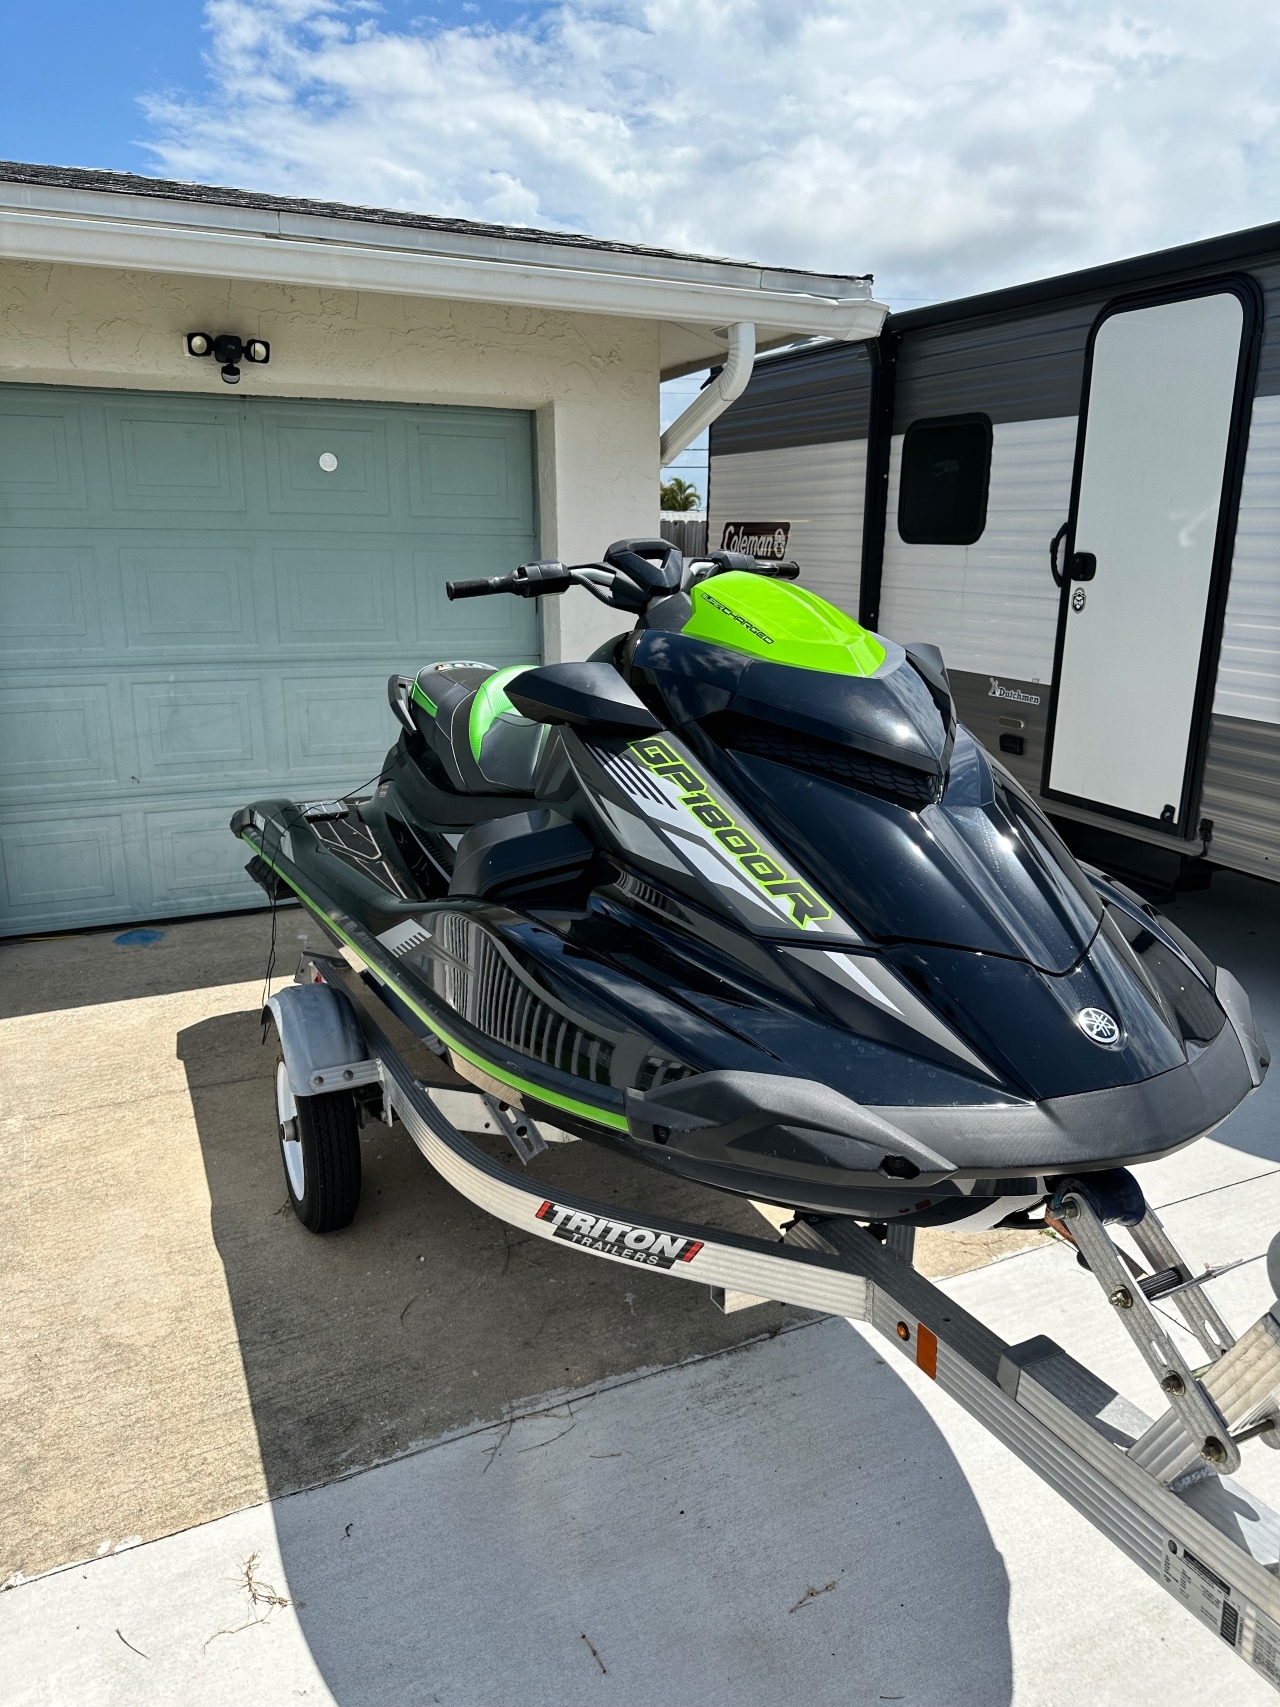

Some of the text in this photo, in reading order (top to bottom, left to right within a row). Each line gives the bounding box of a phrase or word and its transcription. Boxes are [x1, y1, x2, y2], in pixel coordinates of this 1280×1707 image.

[723, 525, 773, 557] Coleman
[998, 687, 1040, 704] Dutchmen
[626, 735, 832, 931] GP1800R
[551, 1204, 688, 1259] TRITON
[571, 1232, 660, 1266] TRAILERS
